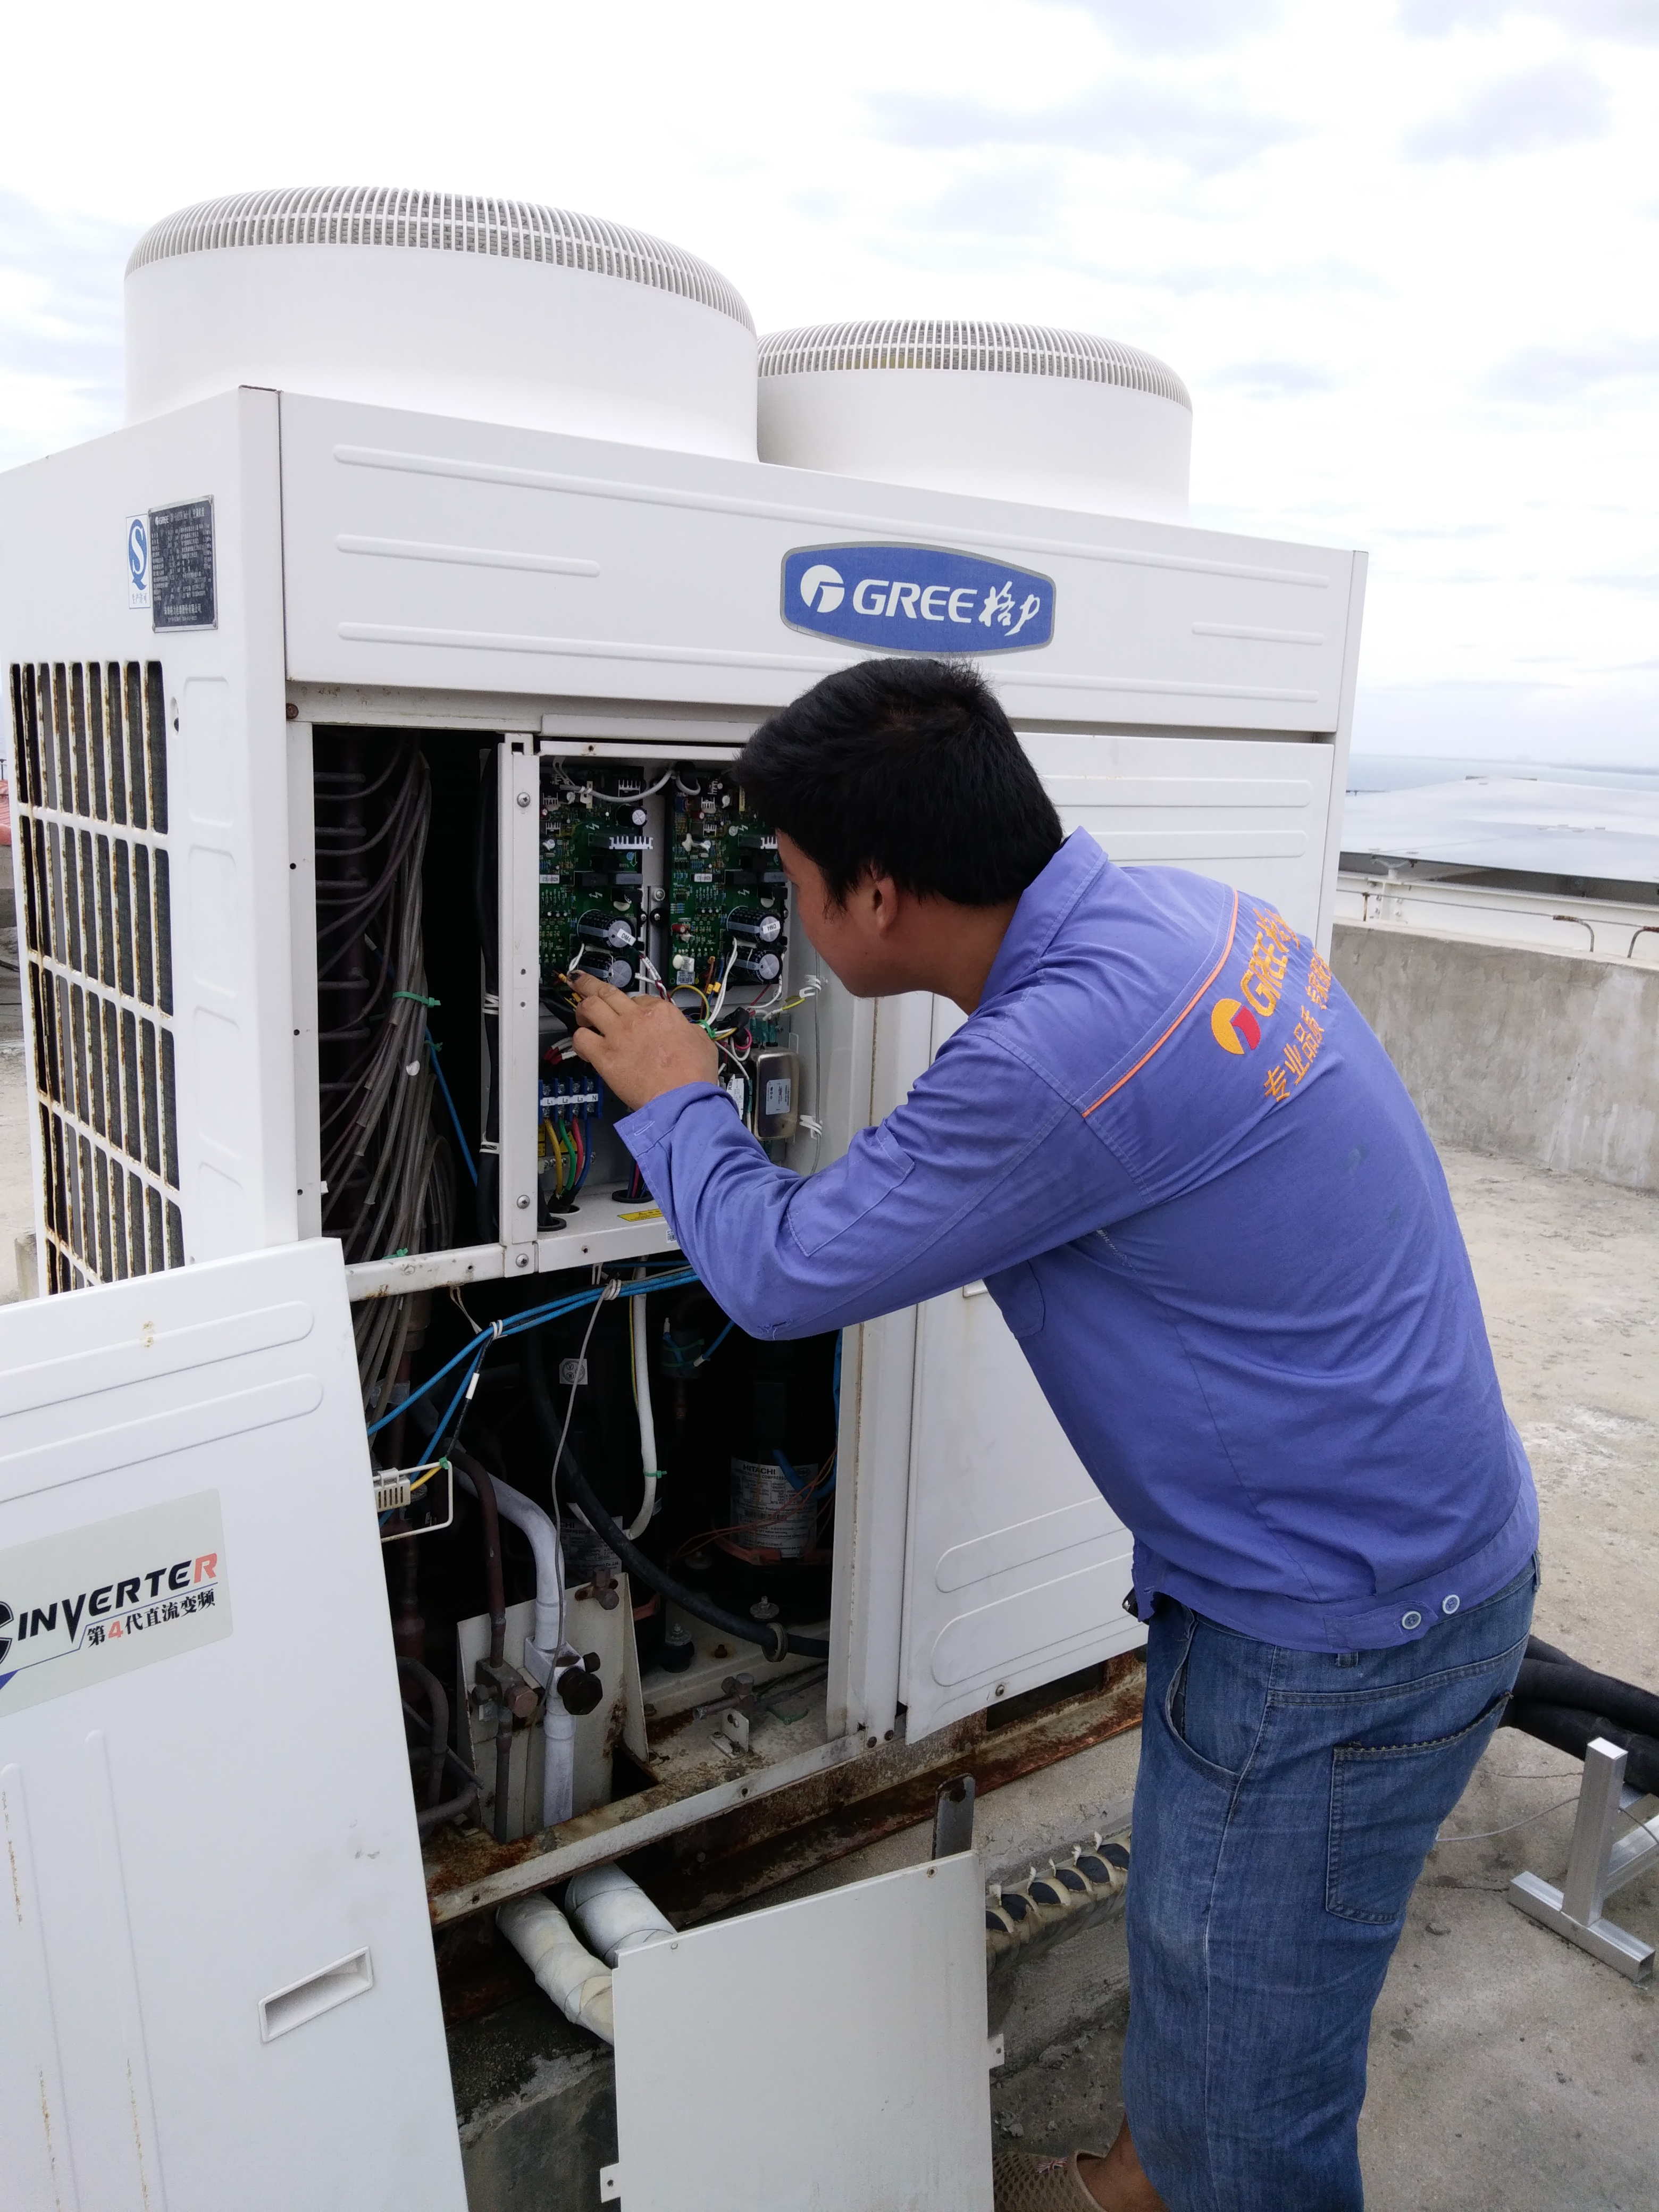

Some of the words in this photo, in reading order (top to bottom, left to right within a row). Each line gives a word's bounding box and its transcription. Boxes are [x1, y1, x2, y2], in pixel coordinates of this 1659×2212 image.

[852, 579, 977, 623] GREE
[1240, 931, 1288, 1017] GREE
[1263, 1005, 1325, 1102] 专业品质
[743, 1464, 776, 1475] HITACHI
[87, 1588, 216, 1648] 第4代直流变频
